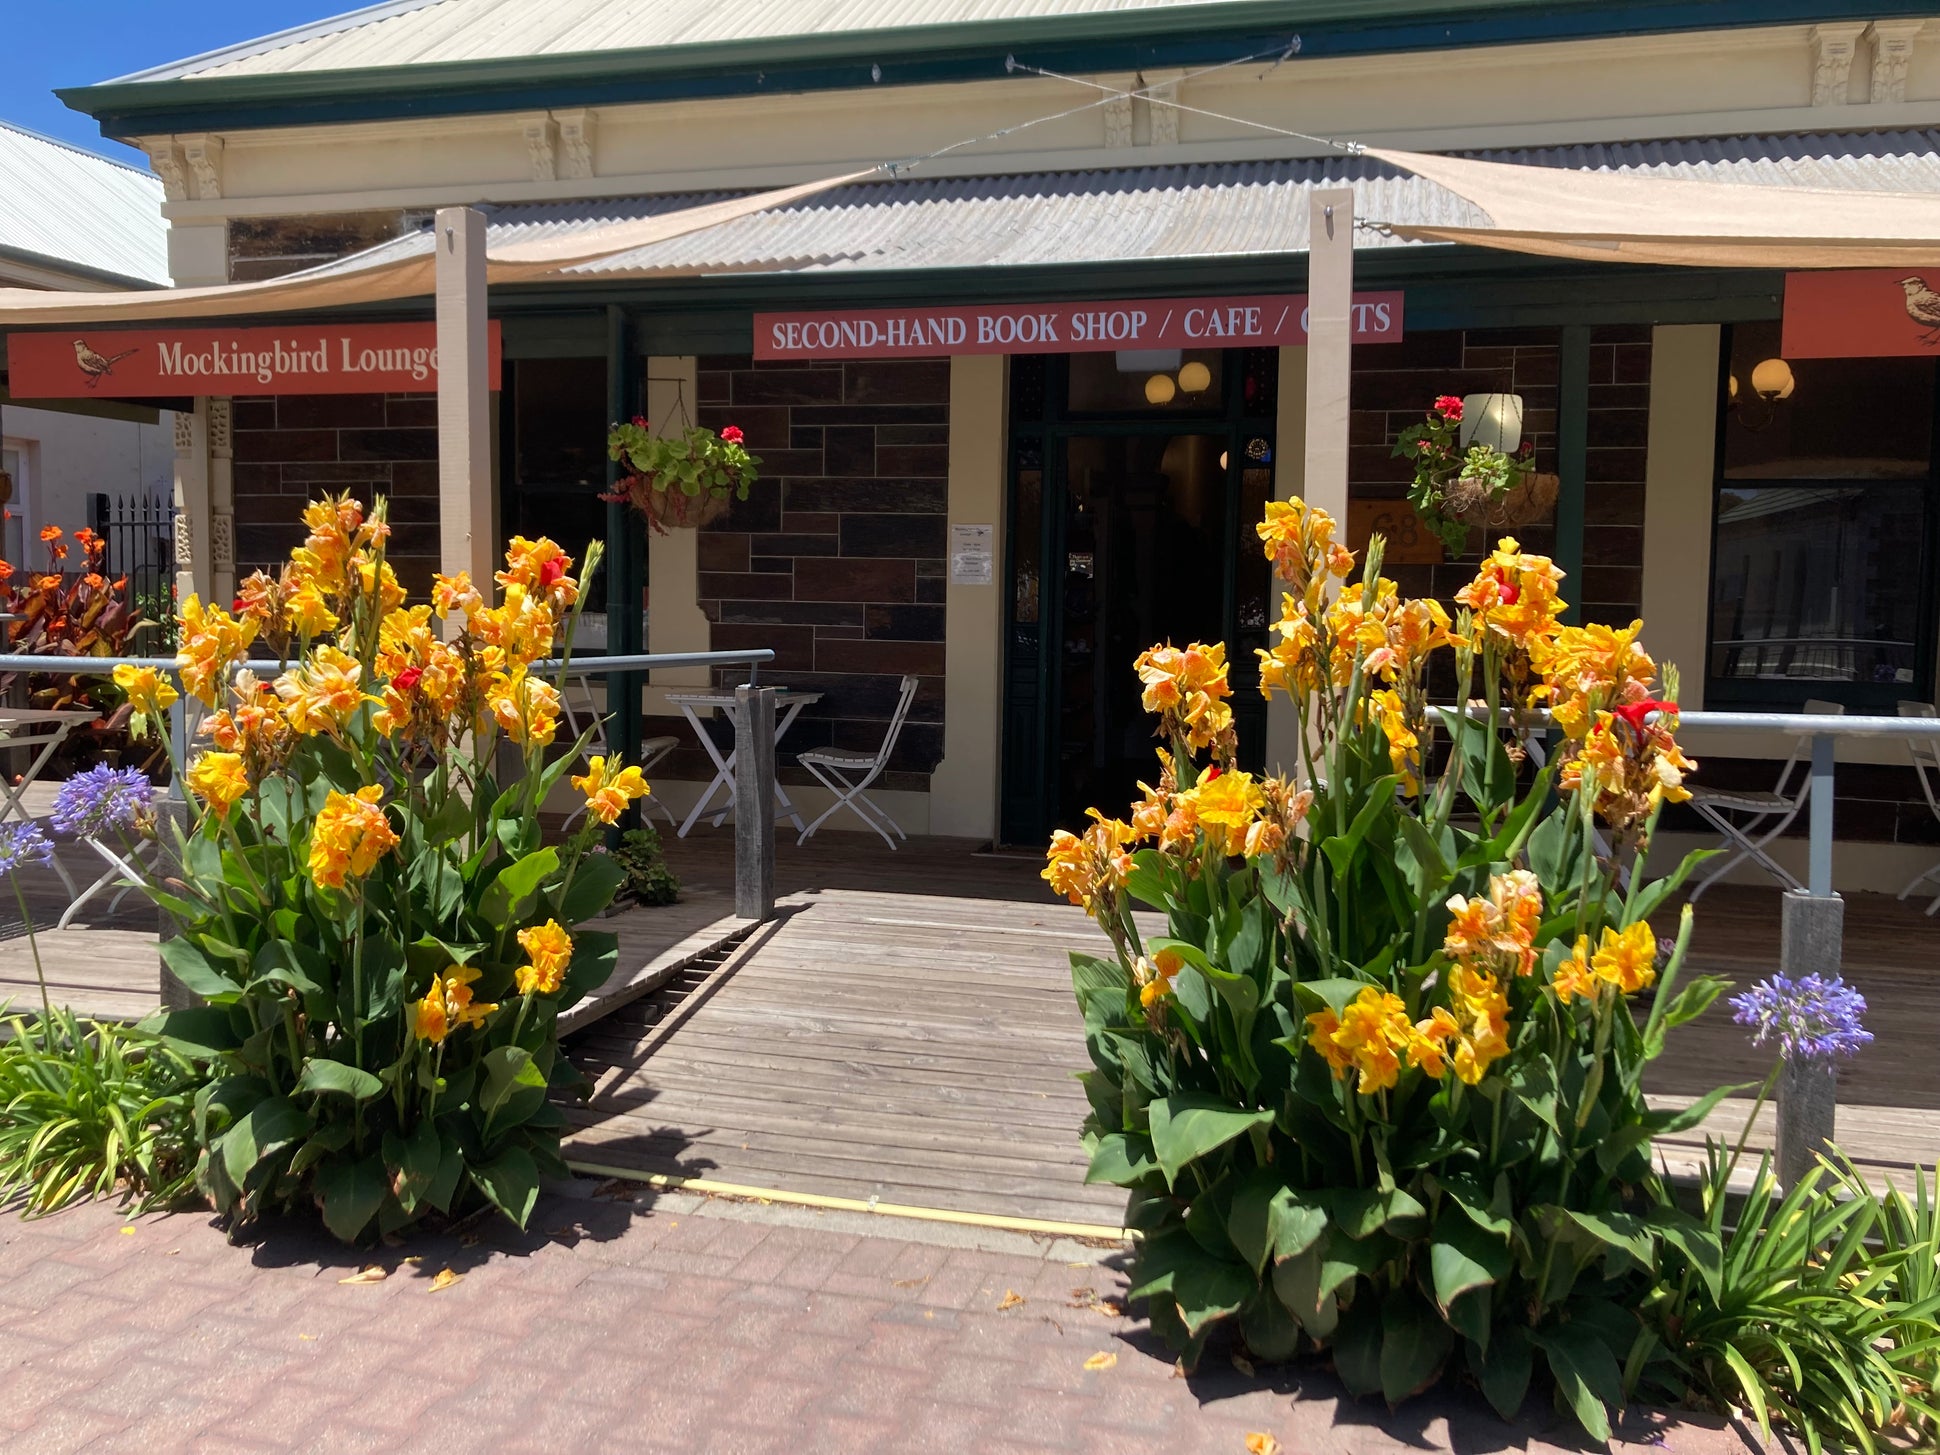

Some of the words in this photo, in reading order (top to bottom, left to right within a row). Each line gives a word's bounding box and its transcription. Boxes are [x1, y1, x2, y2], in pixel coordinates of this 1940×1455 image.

[771, 317, 967, 350] SECOND-HAND
[976, 314, 1060, 344] BOOK
[1070, 310, 1147, 342] SHOP
[1183, 306, 1263, 338] CAFE
[157, 338, 328, 384] Mockingbird
